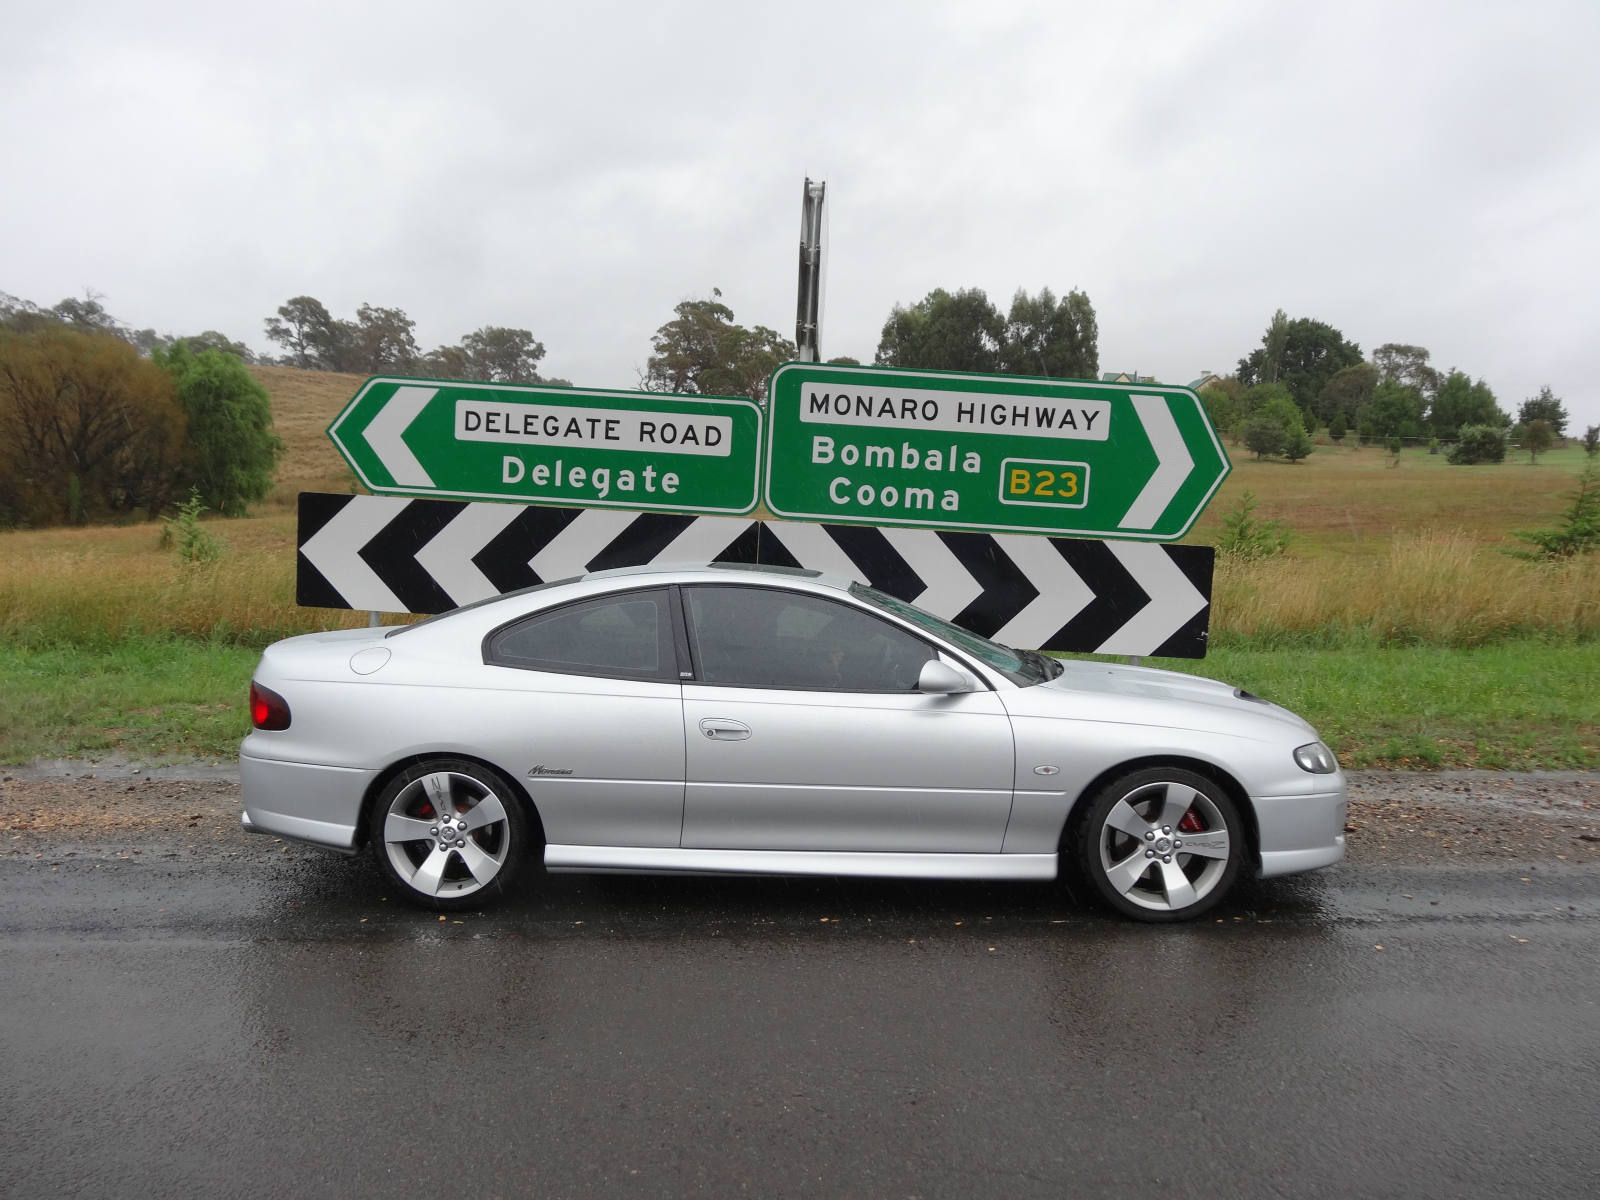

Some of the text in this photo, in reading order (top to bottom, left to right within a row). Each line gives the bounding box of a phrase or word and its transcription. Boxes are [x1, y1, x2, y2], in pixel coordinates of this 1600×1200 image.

[464, 410, 723, 447] DELEGATE ROAD
[809, 392, 1101, 431] MONARO HIGHWAY
[811, 435, 982, 474] Bombala
[502, 455, 681, 499] Delegate
[829, 476, 960, 511] Cooma
[1009, 469, 1078, 497] B23
